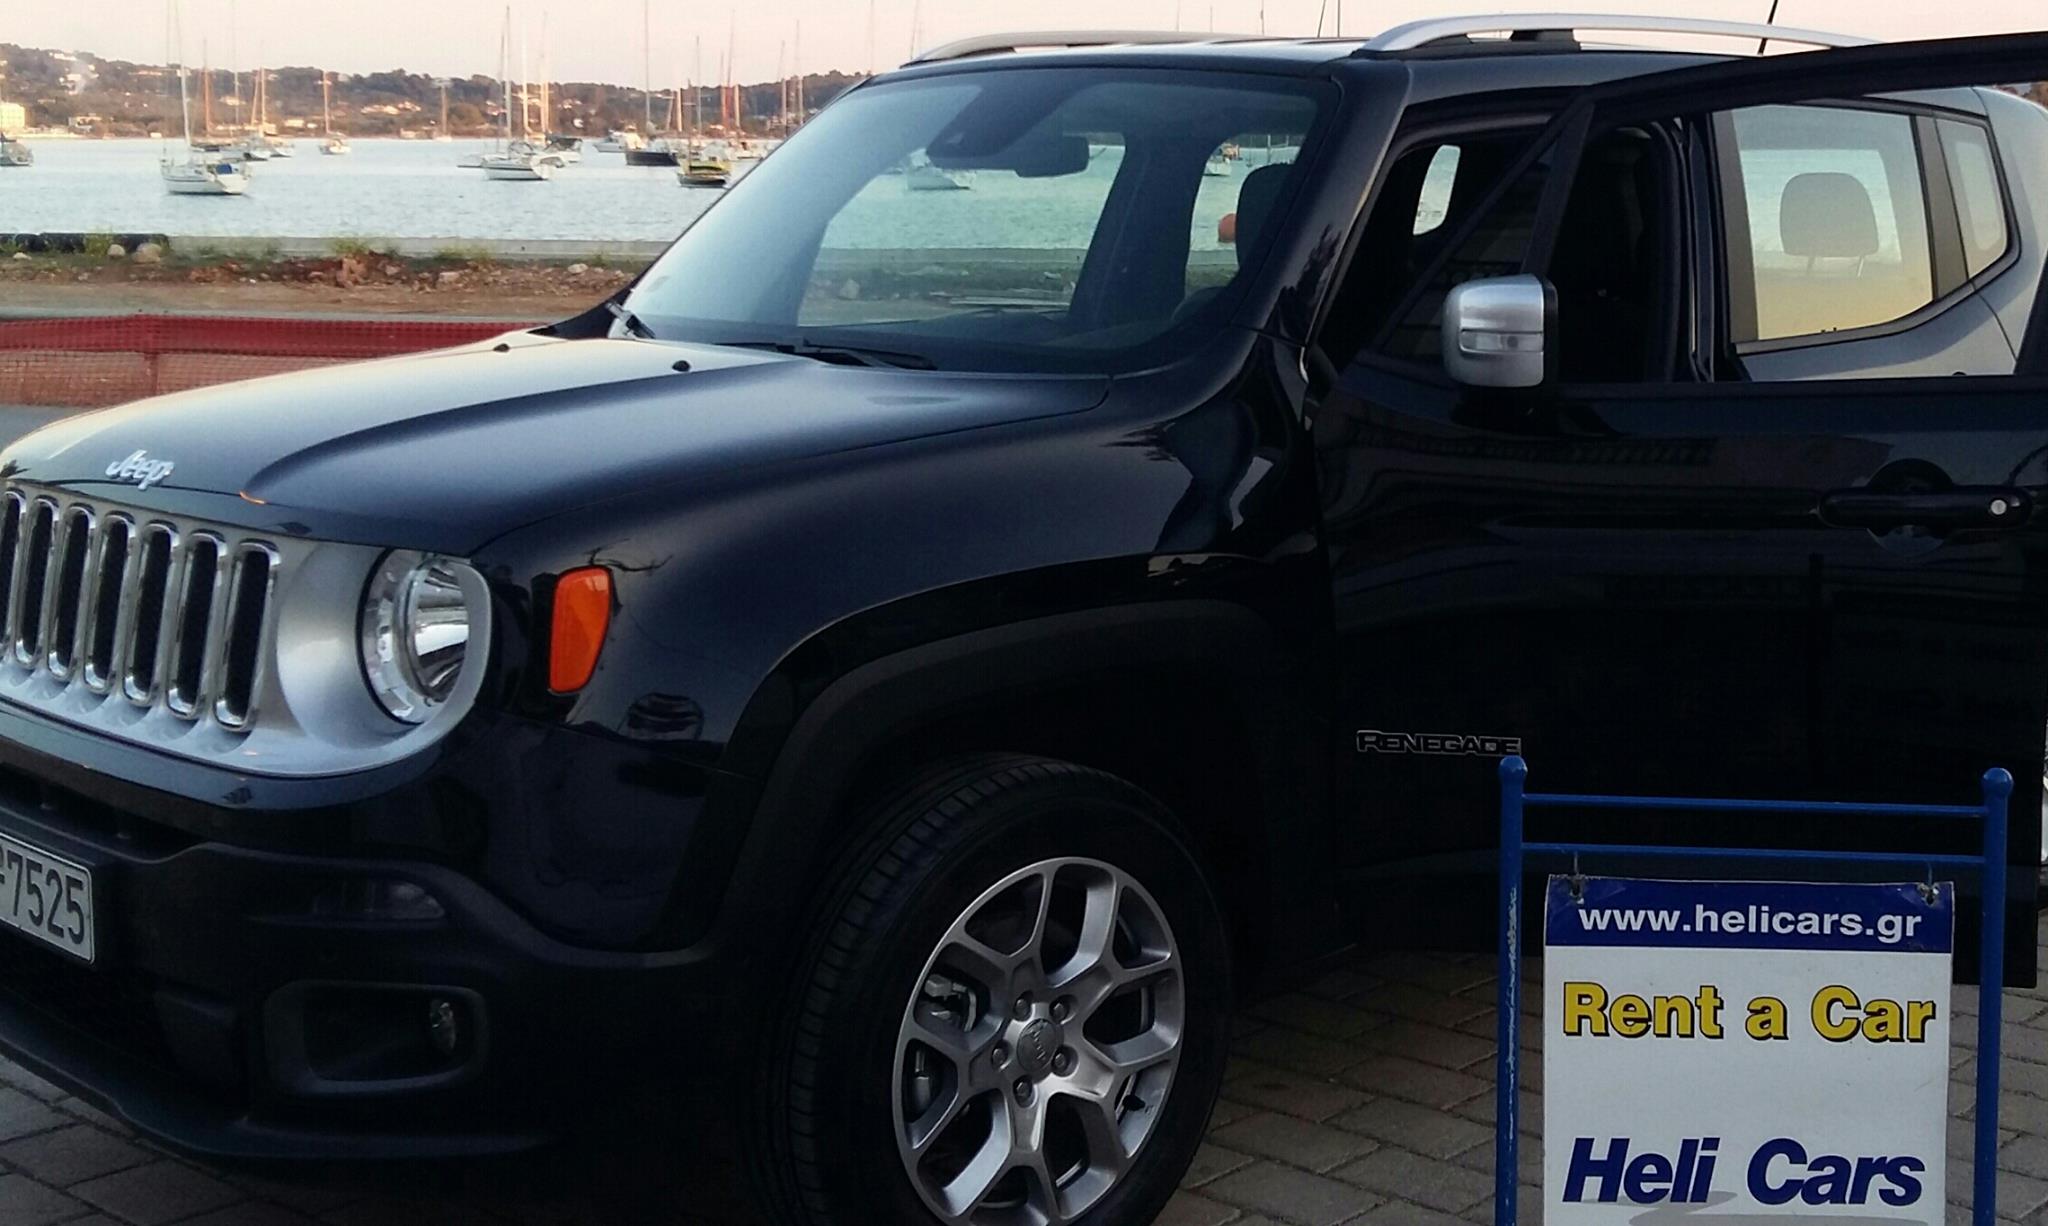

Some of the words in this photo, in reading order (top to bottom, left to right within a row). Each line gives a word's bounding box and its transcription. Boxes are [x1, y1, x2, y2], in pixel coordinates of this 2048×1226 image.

[105, 449, 175, 490] Jeep
[1356, 729, 1522, 757] RENEGADE
[0, 845, 85, 945] -7525
[1578, 904, 1923, 944] www.helicars.gr
[1562, 981, 1724, 1040] Rent
[1744, 996, 1788, 1040] a
[1810, 985, 1936, 1043] Car
[1562, 1137, 1721, 1204] Heli
[1746, 1137, 1926, 1207] Cars
